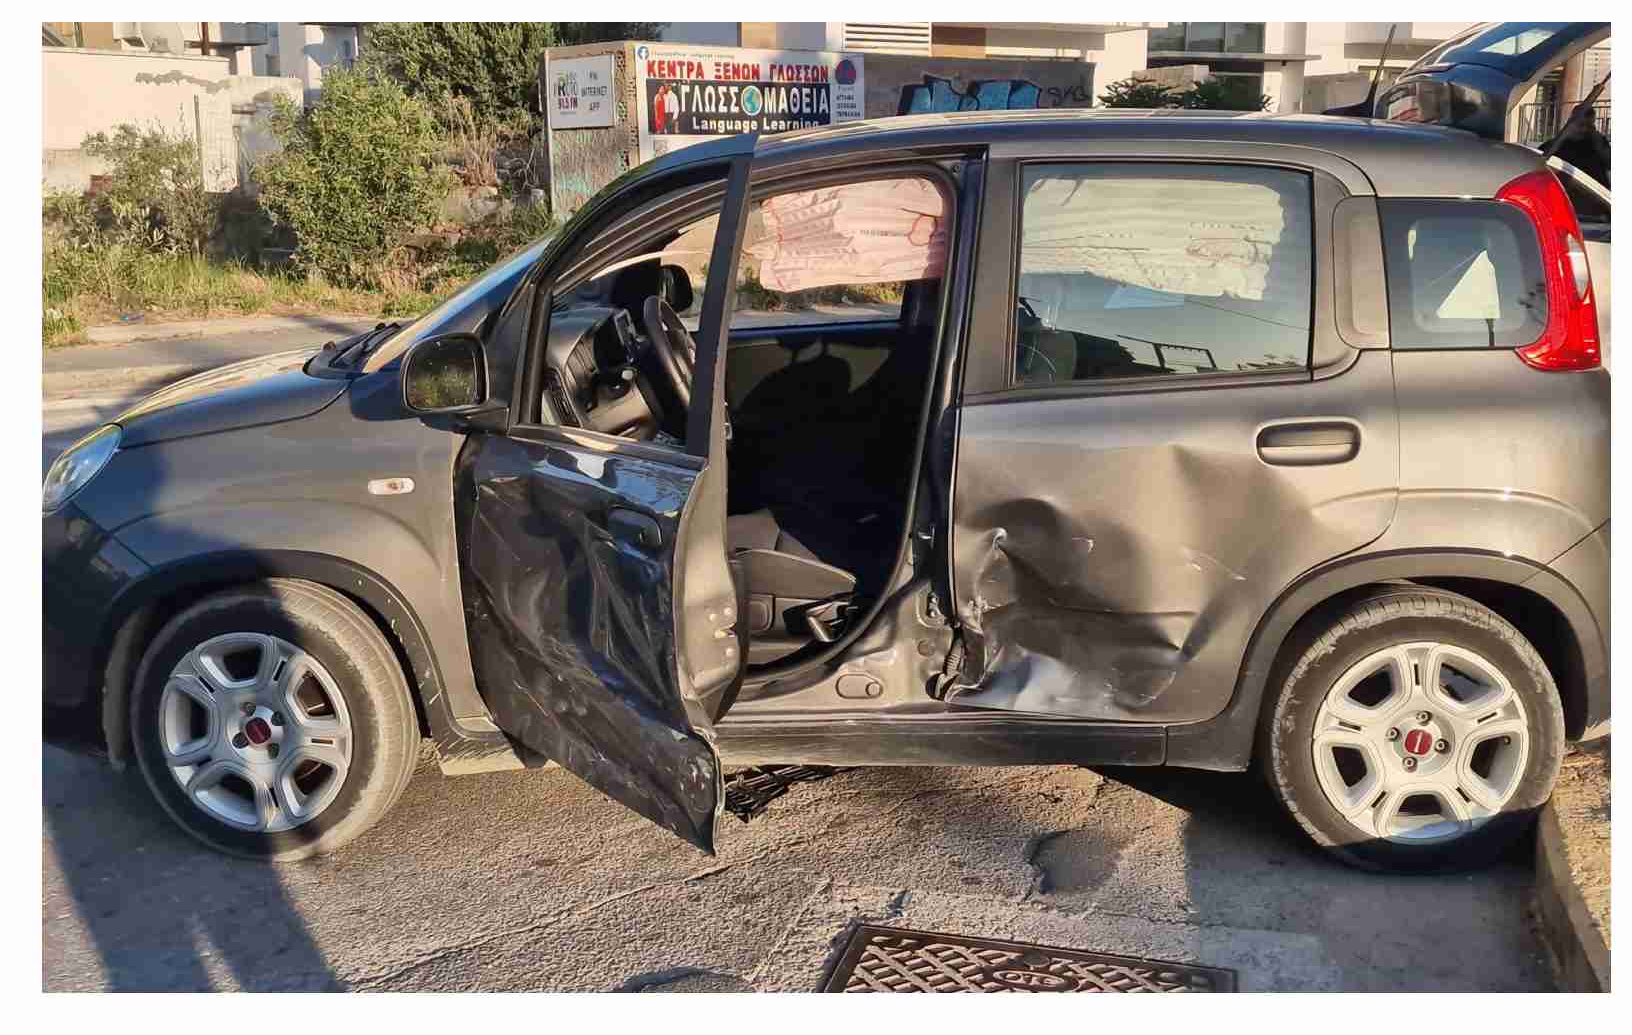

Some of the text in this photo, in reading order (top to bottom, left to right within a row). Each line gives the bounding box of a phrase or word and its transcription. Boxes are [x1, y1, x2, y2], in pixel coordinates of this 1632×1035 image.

[647, 60, 829, 83] ΚΕΝΤΡΑ ΞΕΝΩΝ ΓΛΩΣΣΩΝ
[692, 117, 758, 134] Language
